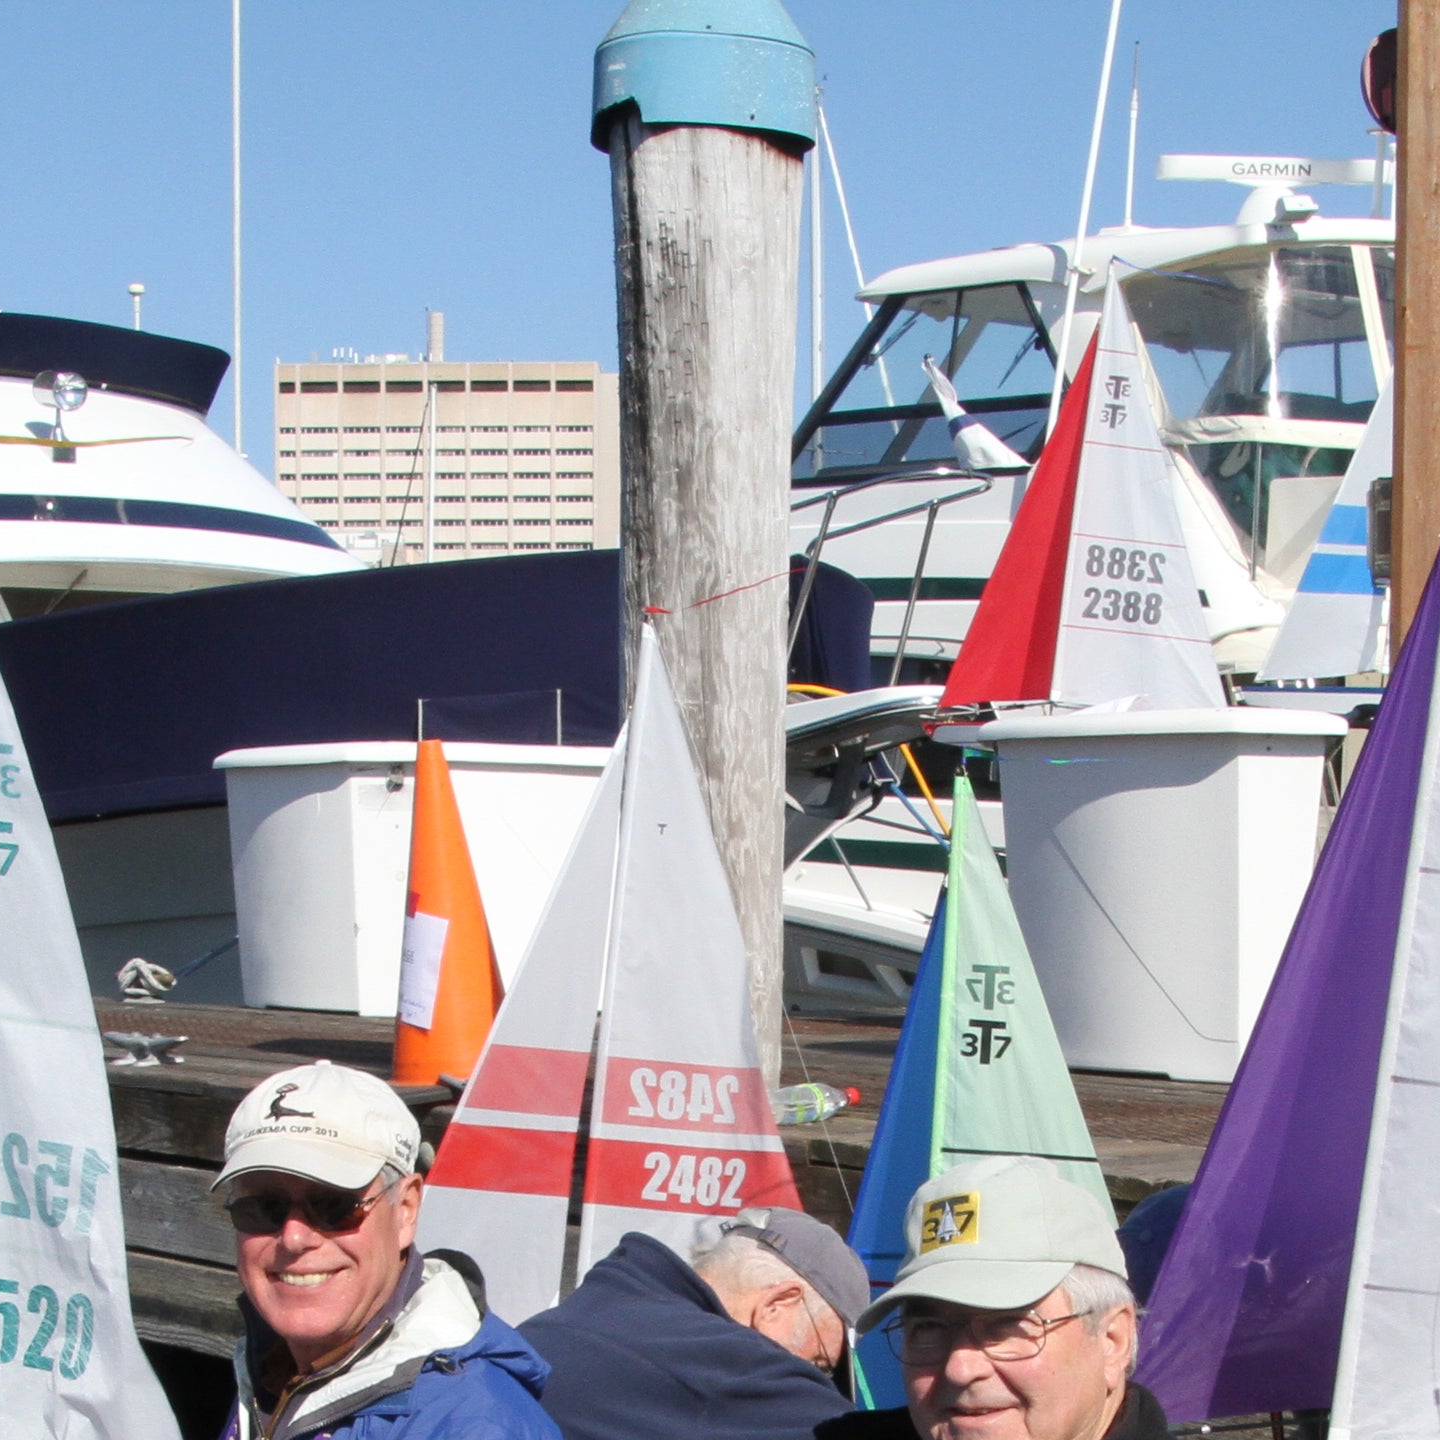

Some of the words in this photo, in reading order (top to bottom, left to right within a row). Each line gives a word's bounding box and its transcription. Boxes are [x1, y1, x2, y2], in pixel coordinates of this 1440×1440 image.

[1231, 162, 1312, 176] GARMIN
[1082, 586, 1163, 626] 2388
[243, 1125, 287, 1139] LEUKEMIA
[289, 1125, 312, 1133] CUP
[315, 1126, 338, 1138] 2013
[641, 1151, 747, 1208] 2482
